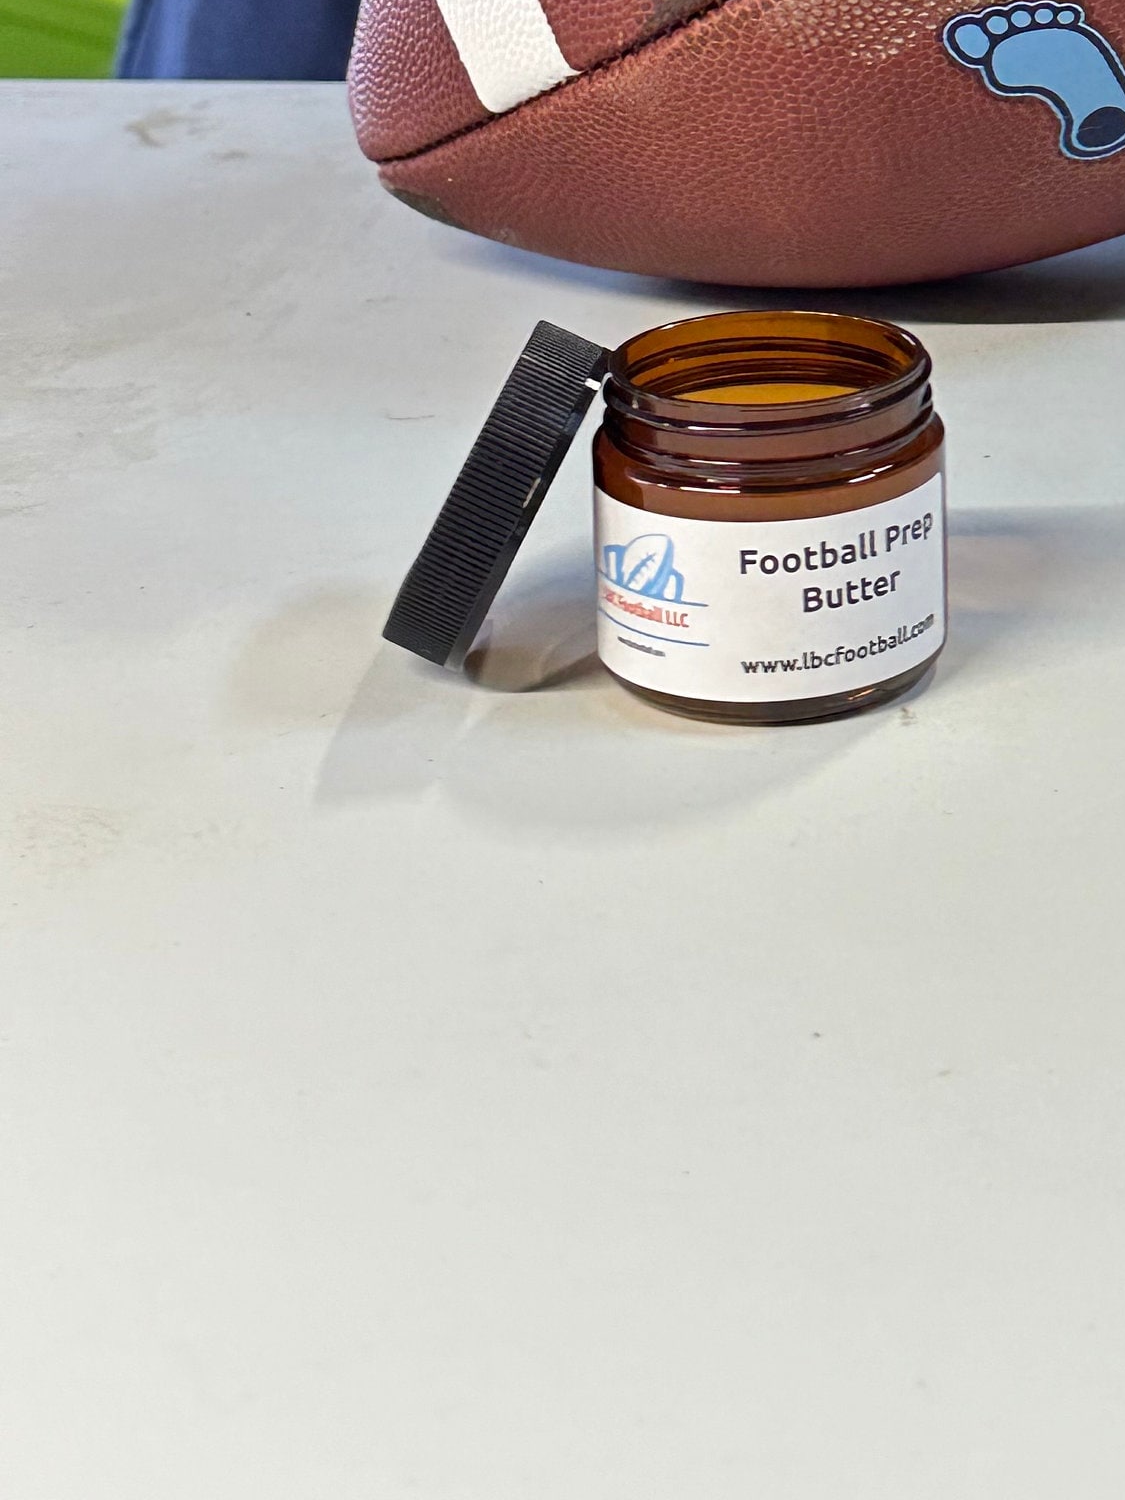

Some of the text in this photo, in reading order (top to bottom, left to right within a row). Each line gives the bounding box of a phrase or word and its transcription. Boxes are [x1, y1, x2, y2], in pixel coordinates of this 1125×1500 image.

[739, 512, 933, 575] Football Prep
[803, 570, 901, 613] Butter
[665, 609, 690, 628] LLC
[740, 613, 935, 674] www.lbcfootball.com
